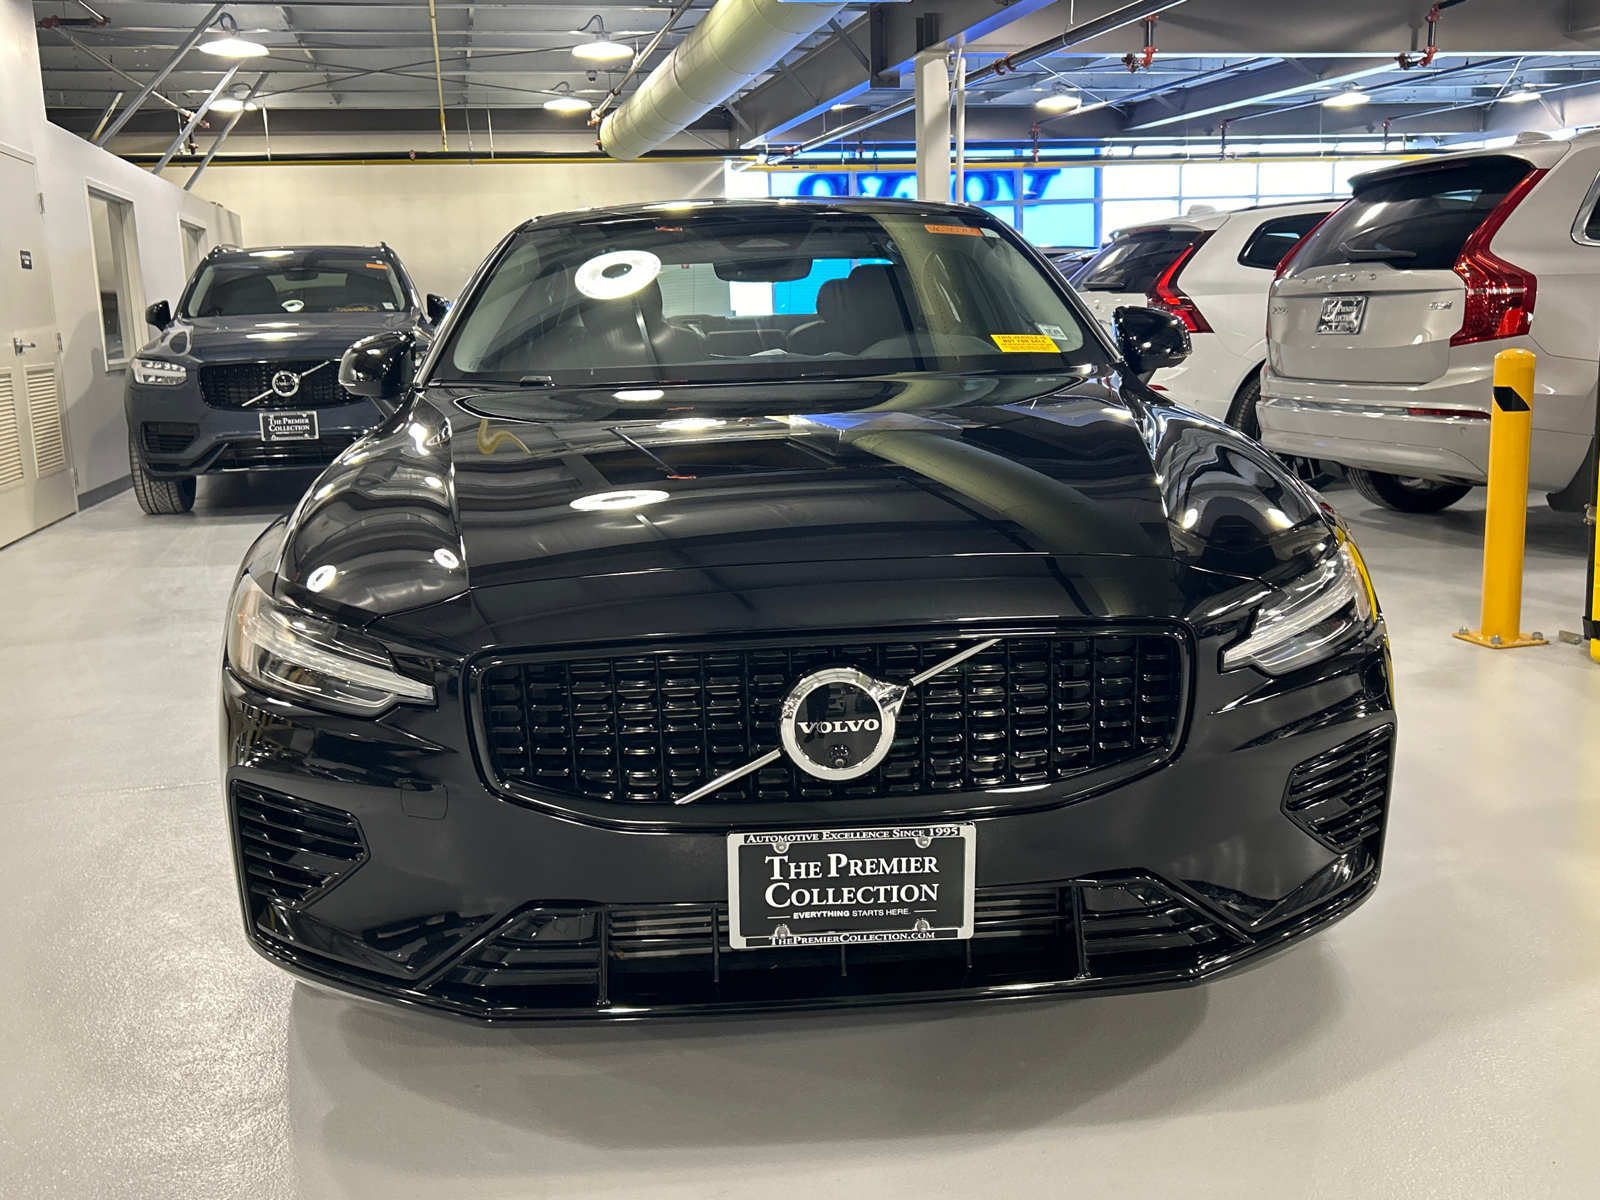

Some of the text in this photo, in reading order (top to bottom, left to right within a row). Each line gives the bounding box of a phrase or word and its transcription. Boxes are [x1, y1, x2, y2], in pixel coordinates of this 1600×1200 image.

[268, 424, 310, 432] COLLECTION
[797, 719, 879, 734] VOLVO
[746, 827, 959, 843] AUTOMOTIVE EXCELLENCE SINCE 1995
[764, 853, 940, 880] THE PREMIER
[764, 882, 940, 908] COLLECTION
[793, 908, 911, 919] EVERYTHING STARTS HERE.
